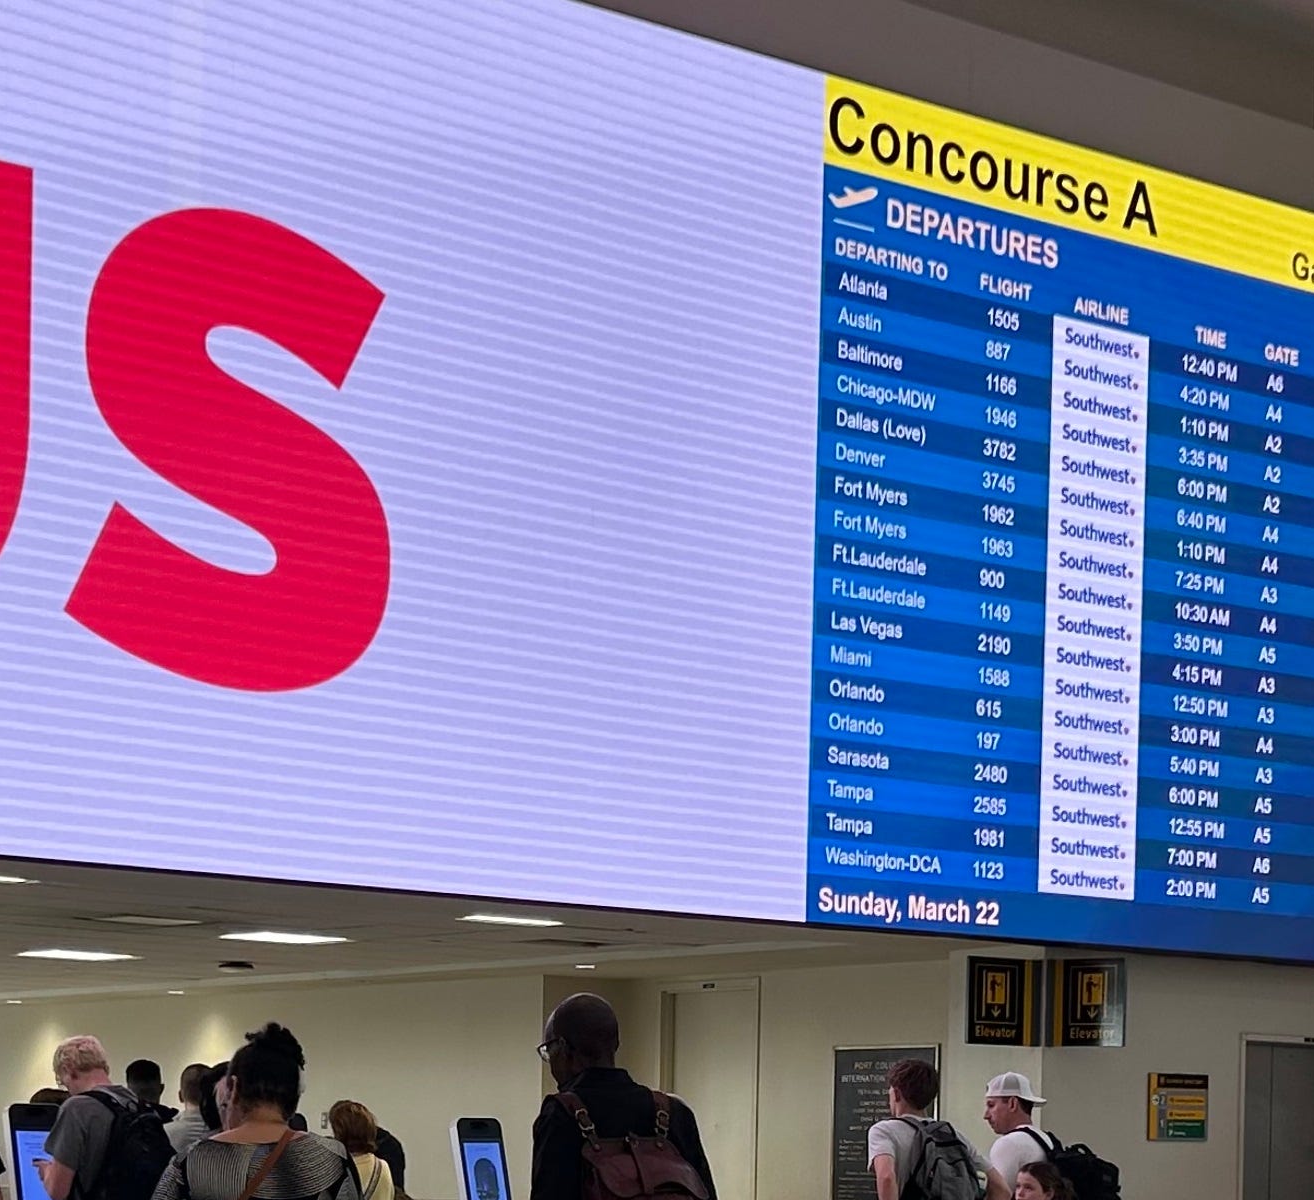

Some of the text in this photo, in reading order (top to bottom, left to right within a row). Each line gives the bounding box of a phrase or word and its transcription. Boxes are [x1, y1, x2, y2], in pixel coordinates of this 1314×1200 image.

[829, 97, 1158, 238] Concourse A
[887, 198, 1059, 269] DEPARTURES
[835, 237, 924, 275] DEPARTING
[927, 260, 949, 282] TO
[980, 273, 1033, 302] FLIGHT
[1074, 297, 1129, 326] AIRLINE
[1195, 326, 1227, 350] TIME
[1264, 343, 1299, 367] GATE
[838, 272, 888, 301] Atlanta
[987, 307, 1020, 332] 1505
[1065, 327, 1132, 359] Southwest
[1182, 354, 1216, 378] 12:40
[1217, 361, 1238, 383] PM
[1266, 374, 1284, 394] A6
[838, 307, 1283, 424] Austin 887 4:20 PM A4
[838, 339, 1229, 443] Baltimore 1166 Southwest 1:10 PM
[836, 408, 880, 434] Dallas
[883, 418, 927, 447] (Love)
[983, 438, 1017, 462] 3782
[1061, 455, 1129, 485] Southwest
[1177, 477, 1205, 499] 6:00
[1207, 483, 1228, 504] PM
[1263, 495, 1281, 515] A2
[837, 375, 1229, 473] Chicago-MDW 1946 3:35 PM
[835, 442, 1227, 534] Denver 3745 6:40 PM
[835, 476, 863, 499] Fort
[866, 481, 908, 507] Myers
[982, 504, 1015, 526] 1962
[1060, 519, 1128, 548] Southwest
[1177, 540, 1203, 561] 1:10
[1205, 545, 1226, 565] PM
[833, 543, 927, 577] Ft.Lauderdale
[980, 568, 1005, 589] 900
[1058, 583, 1126, 610] Southwest
[1175, 602, 1209, 623] 10:30
[1209, 607, 1230, 627] AM
[834, 510, 862, 532] Fort
[865, 515, 907, 540] Myers
[981, 537, 1014, 558] 1963
[1175, 570, 1203, 591] 7:25
[1204, 576, 1225, 595] PM
[831, 611, 1223, 687] Las Vegas 2190 Southwest 4:15 PM
[832, 577, 1277, 665] Ft.Lauderdale 1149 3:50 PM A5
[829, 678, 885, 703] Orlando
[976, 699, 1002, 719] 615
[1054, 710, 1123, 736] Southwest
[1170, 725, 1198, 745] 3:00
[1199, 728, 1221, 748] PM
[831, 645, 872, 667] Miami
[978, 667, 1010, 688] 1588
[1173, 695, 1206, 715] 12:50
[1207, 699, 1229, 718] PM
[827, 745, 1272, 815] Sarasota 2480 Southwest 6:00 PM A5
[829, 713, 1220, 778] Orlando 197 5:40 PM
[826, 812, 1271, 874] Tampa 1981 Southwest 7:00 PM A6
[827, 779, 874, 804] Tampa
[973, 796, 1007, 816] 2585
[1169, 818, 1203, 837] 12:55
[1204, 821, 1225, 840] PM
[818, 887, 902, 924] Sunday,
[908, 894, 971, 924] March
[975, 900, 1000, 926] 22
[825, 846, 1217, 900] Washington-DCA 1123 2:00 PM
[975, 1025, 1017, 1039] Elevator
[1069, 1027, 1115, 1039] Elevator
